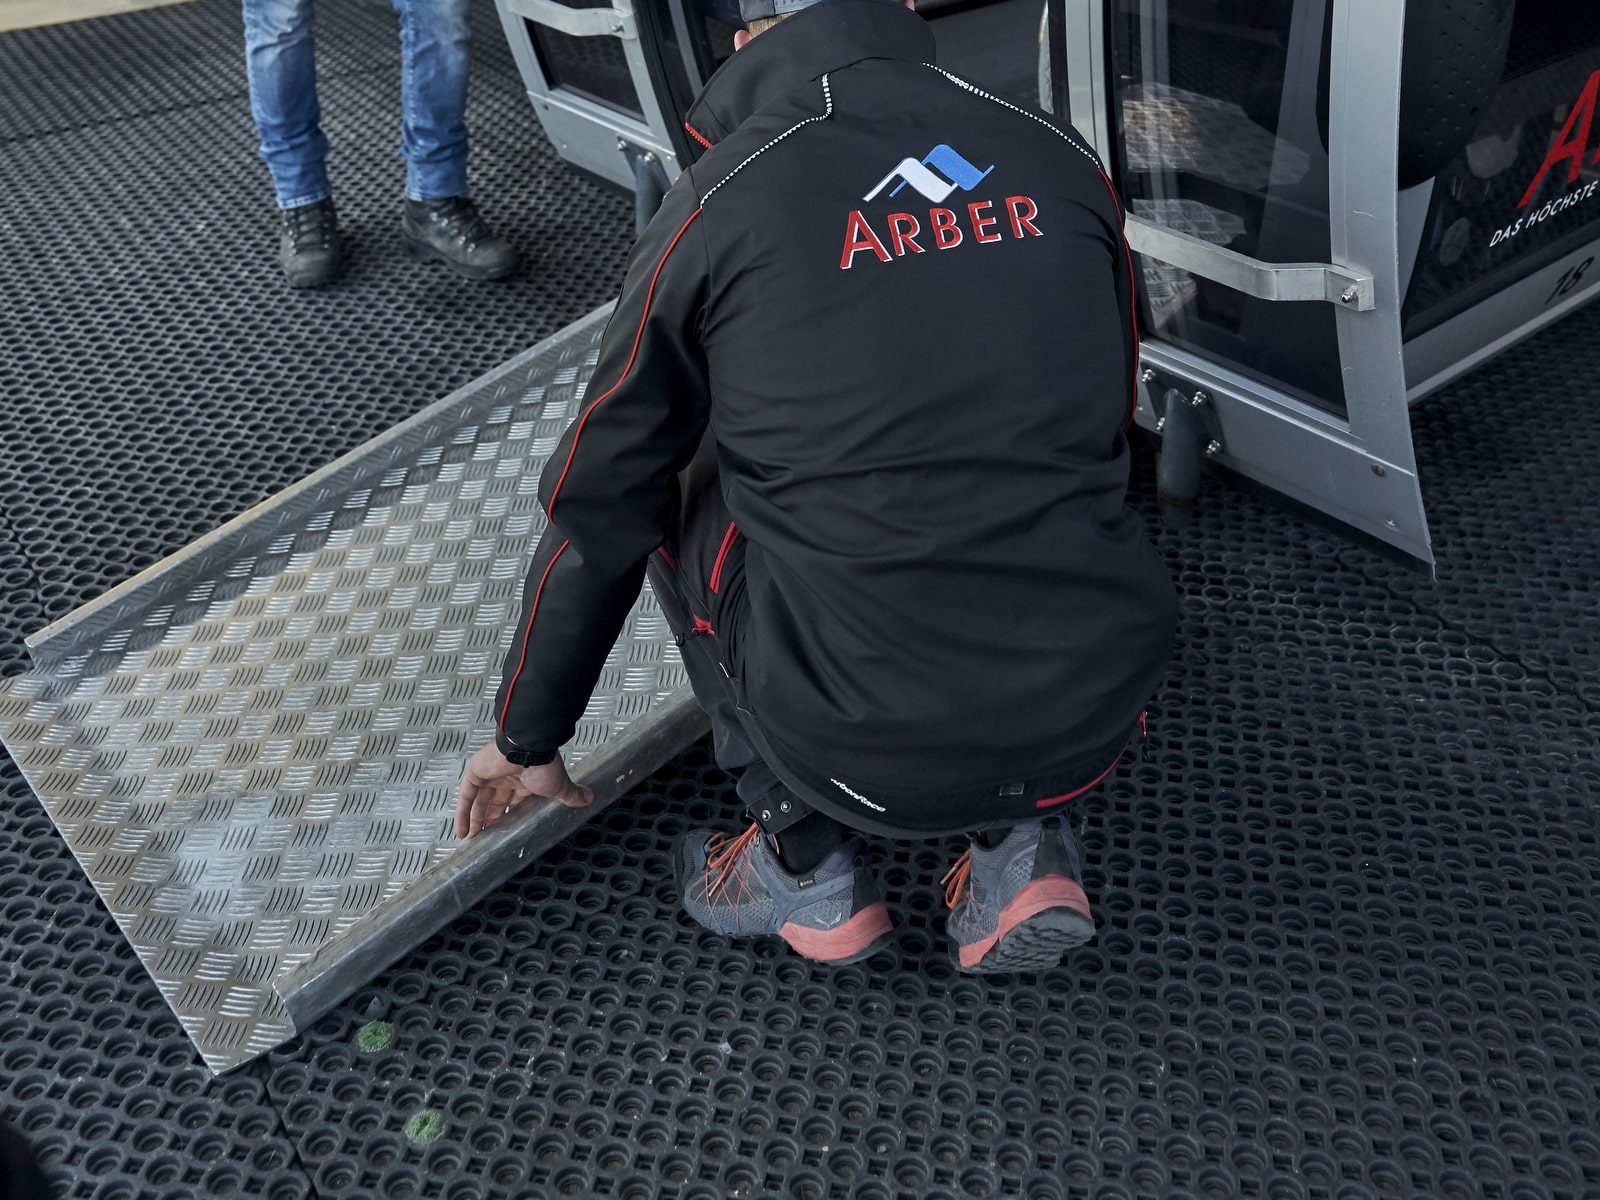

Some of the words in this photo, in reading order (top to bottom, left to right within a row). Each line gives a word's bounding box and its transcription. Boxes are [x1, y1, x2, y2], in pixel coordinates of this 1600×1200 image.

[840, 194, 1045, 271] ARBER
[1490, 218, 1524, 248] DAS
[1525, 179, 1599, 230] HÖCHSTE
[1544, 255, 1596, 305] 18
